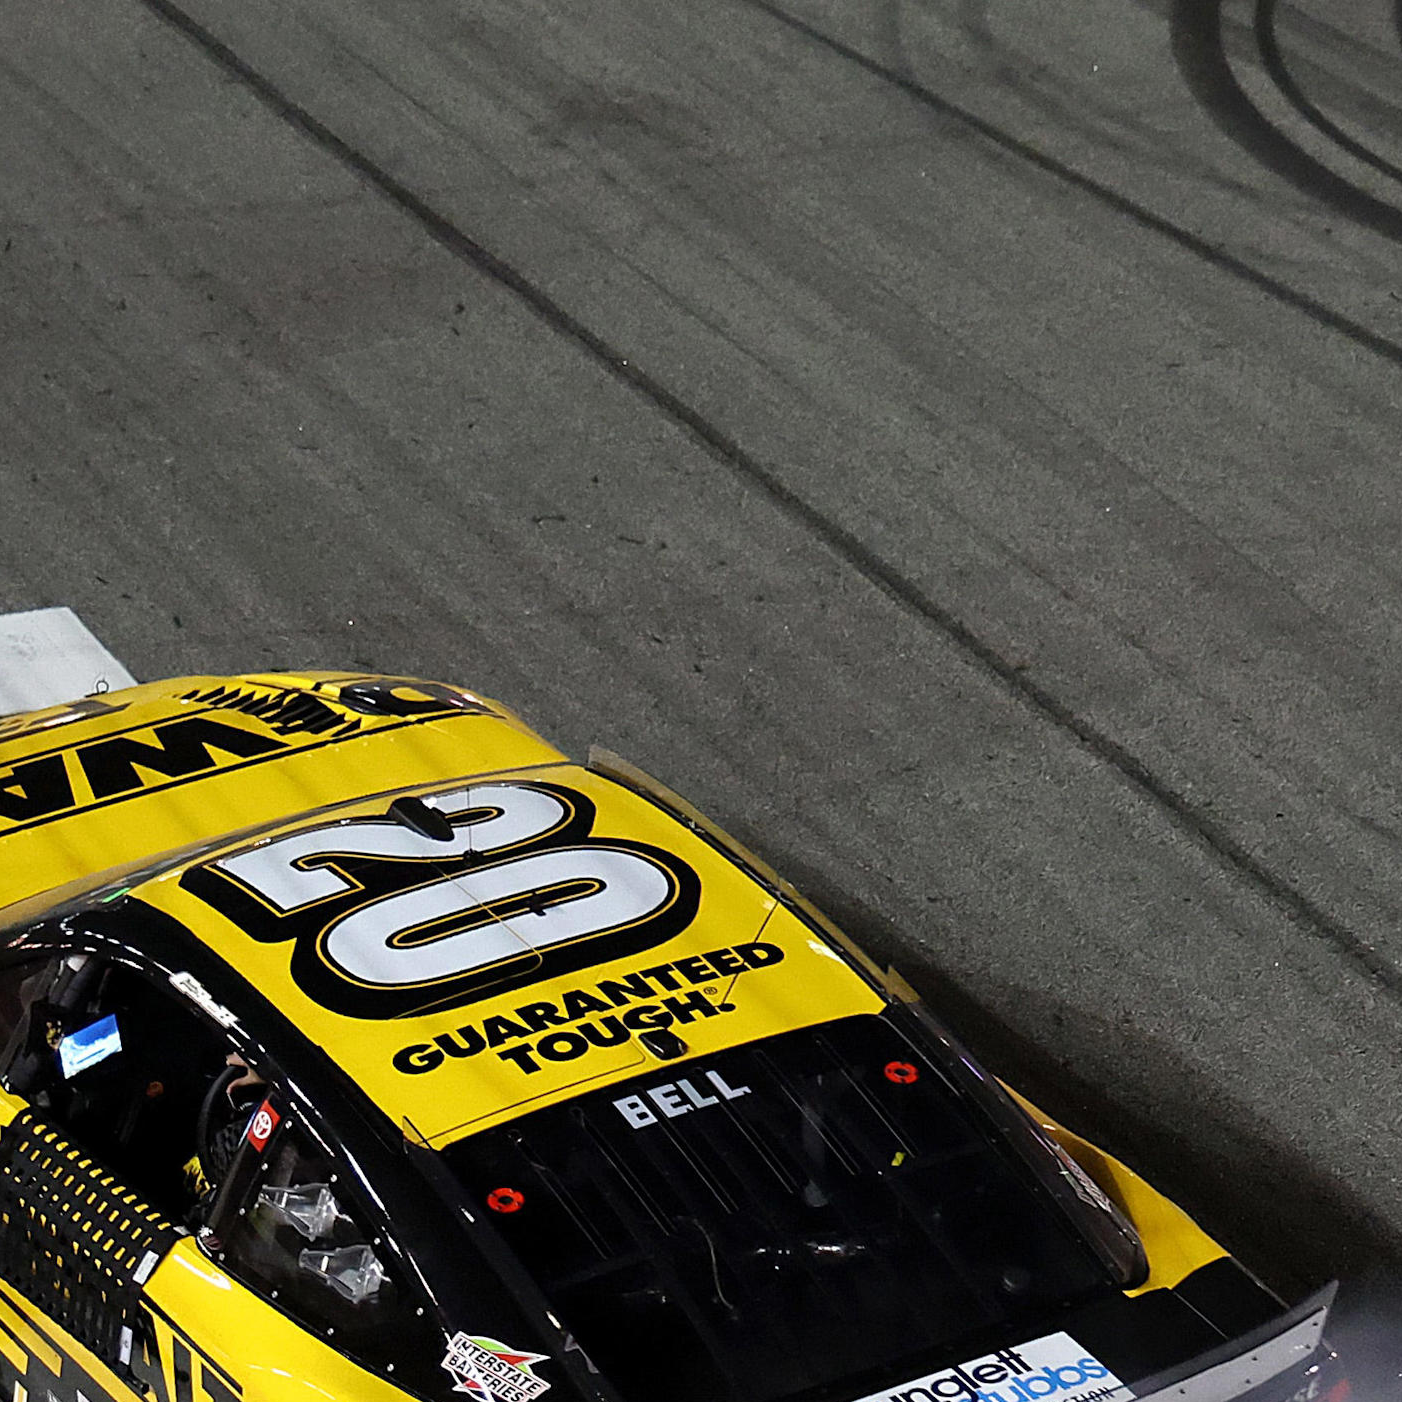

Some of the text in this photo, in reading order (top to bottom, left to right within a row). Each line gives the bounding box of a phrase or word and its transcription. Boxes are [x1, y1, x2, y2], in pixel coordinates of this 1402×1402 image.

[193, 780, 688, 1000] 20
[392, 942, 785, 1075] GUARANTEED
[614, 1068, 752, 1131] BELL
[453, 1338, 542, 1395] INTERSTATE
